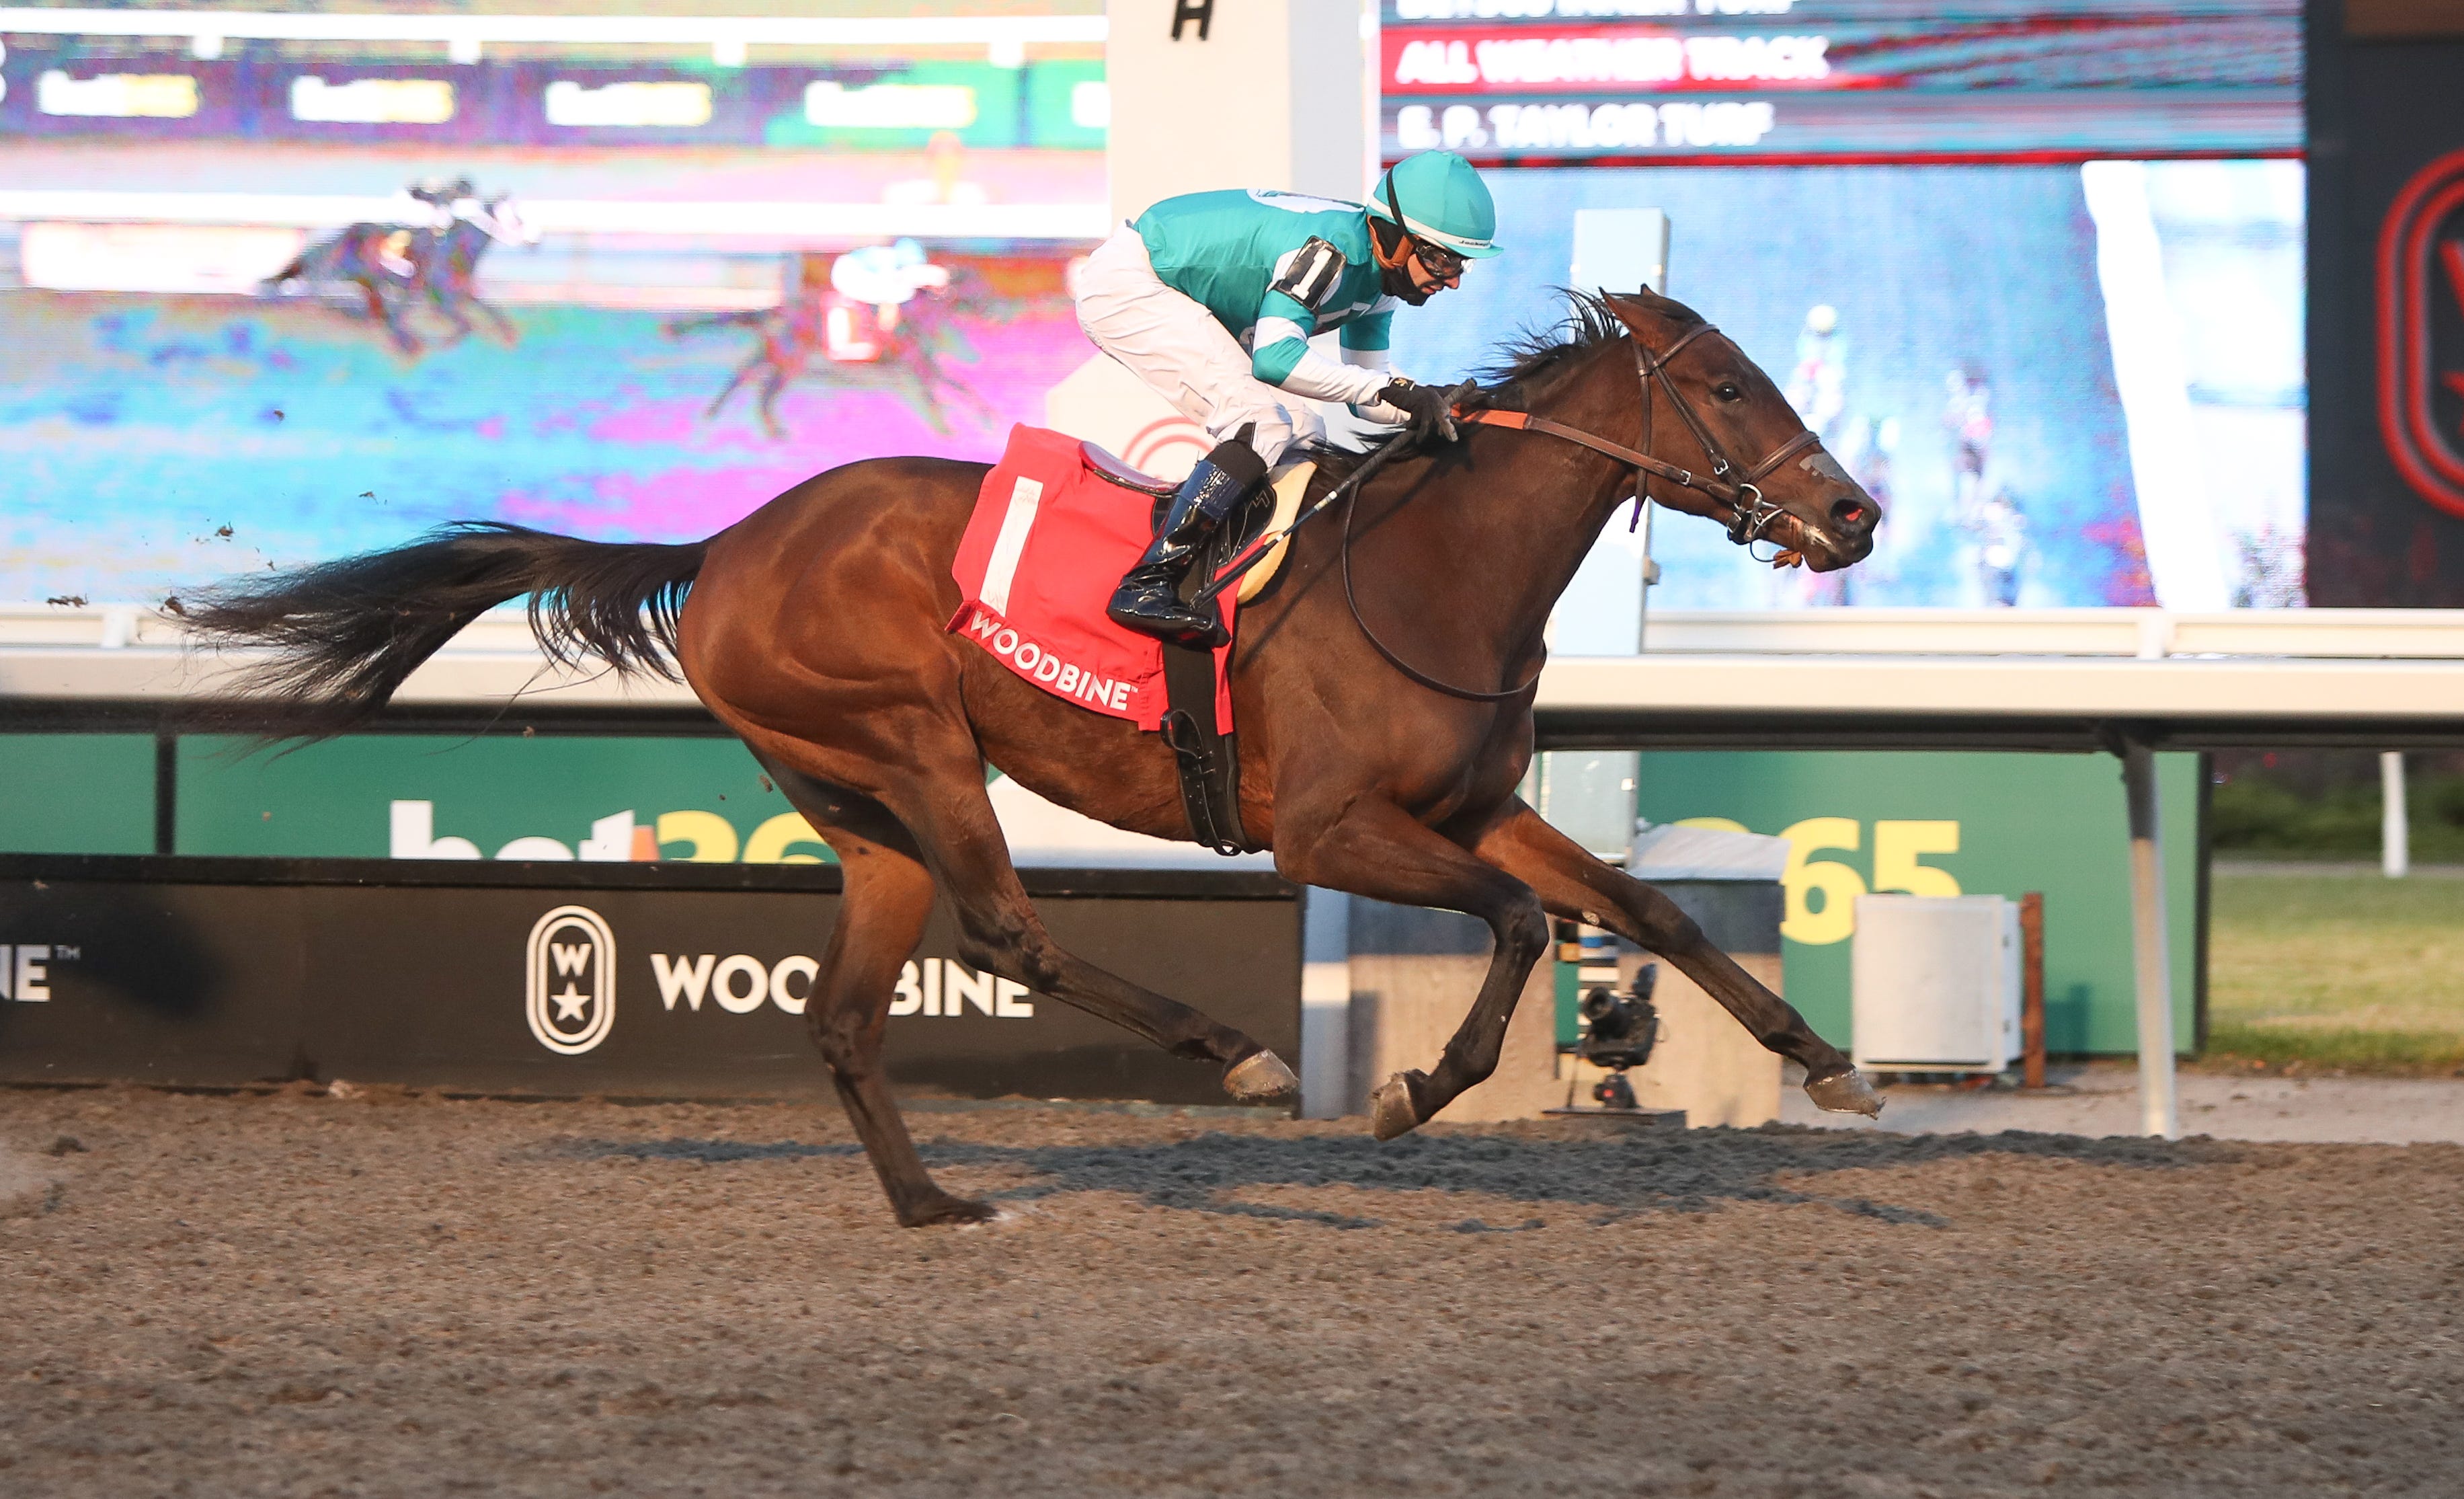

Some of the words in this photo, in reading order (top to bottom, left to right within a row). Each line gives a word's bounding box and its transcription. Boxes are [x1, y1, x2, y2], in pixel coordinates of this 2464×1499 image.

[1291, 249, 1333, 300] 1
[979, 475, 1043, 617] 1
[1672, 816, 1962, 945] 65
[650, 954, 1034, 1017] WOOBINE
